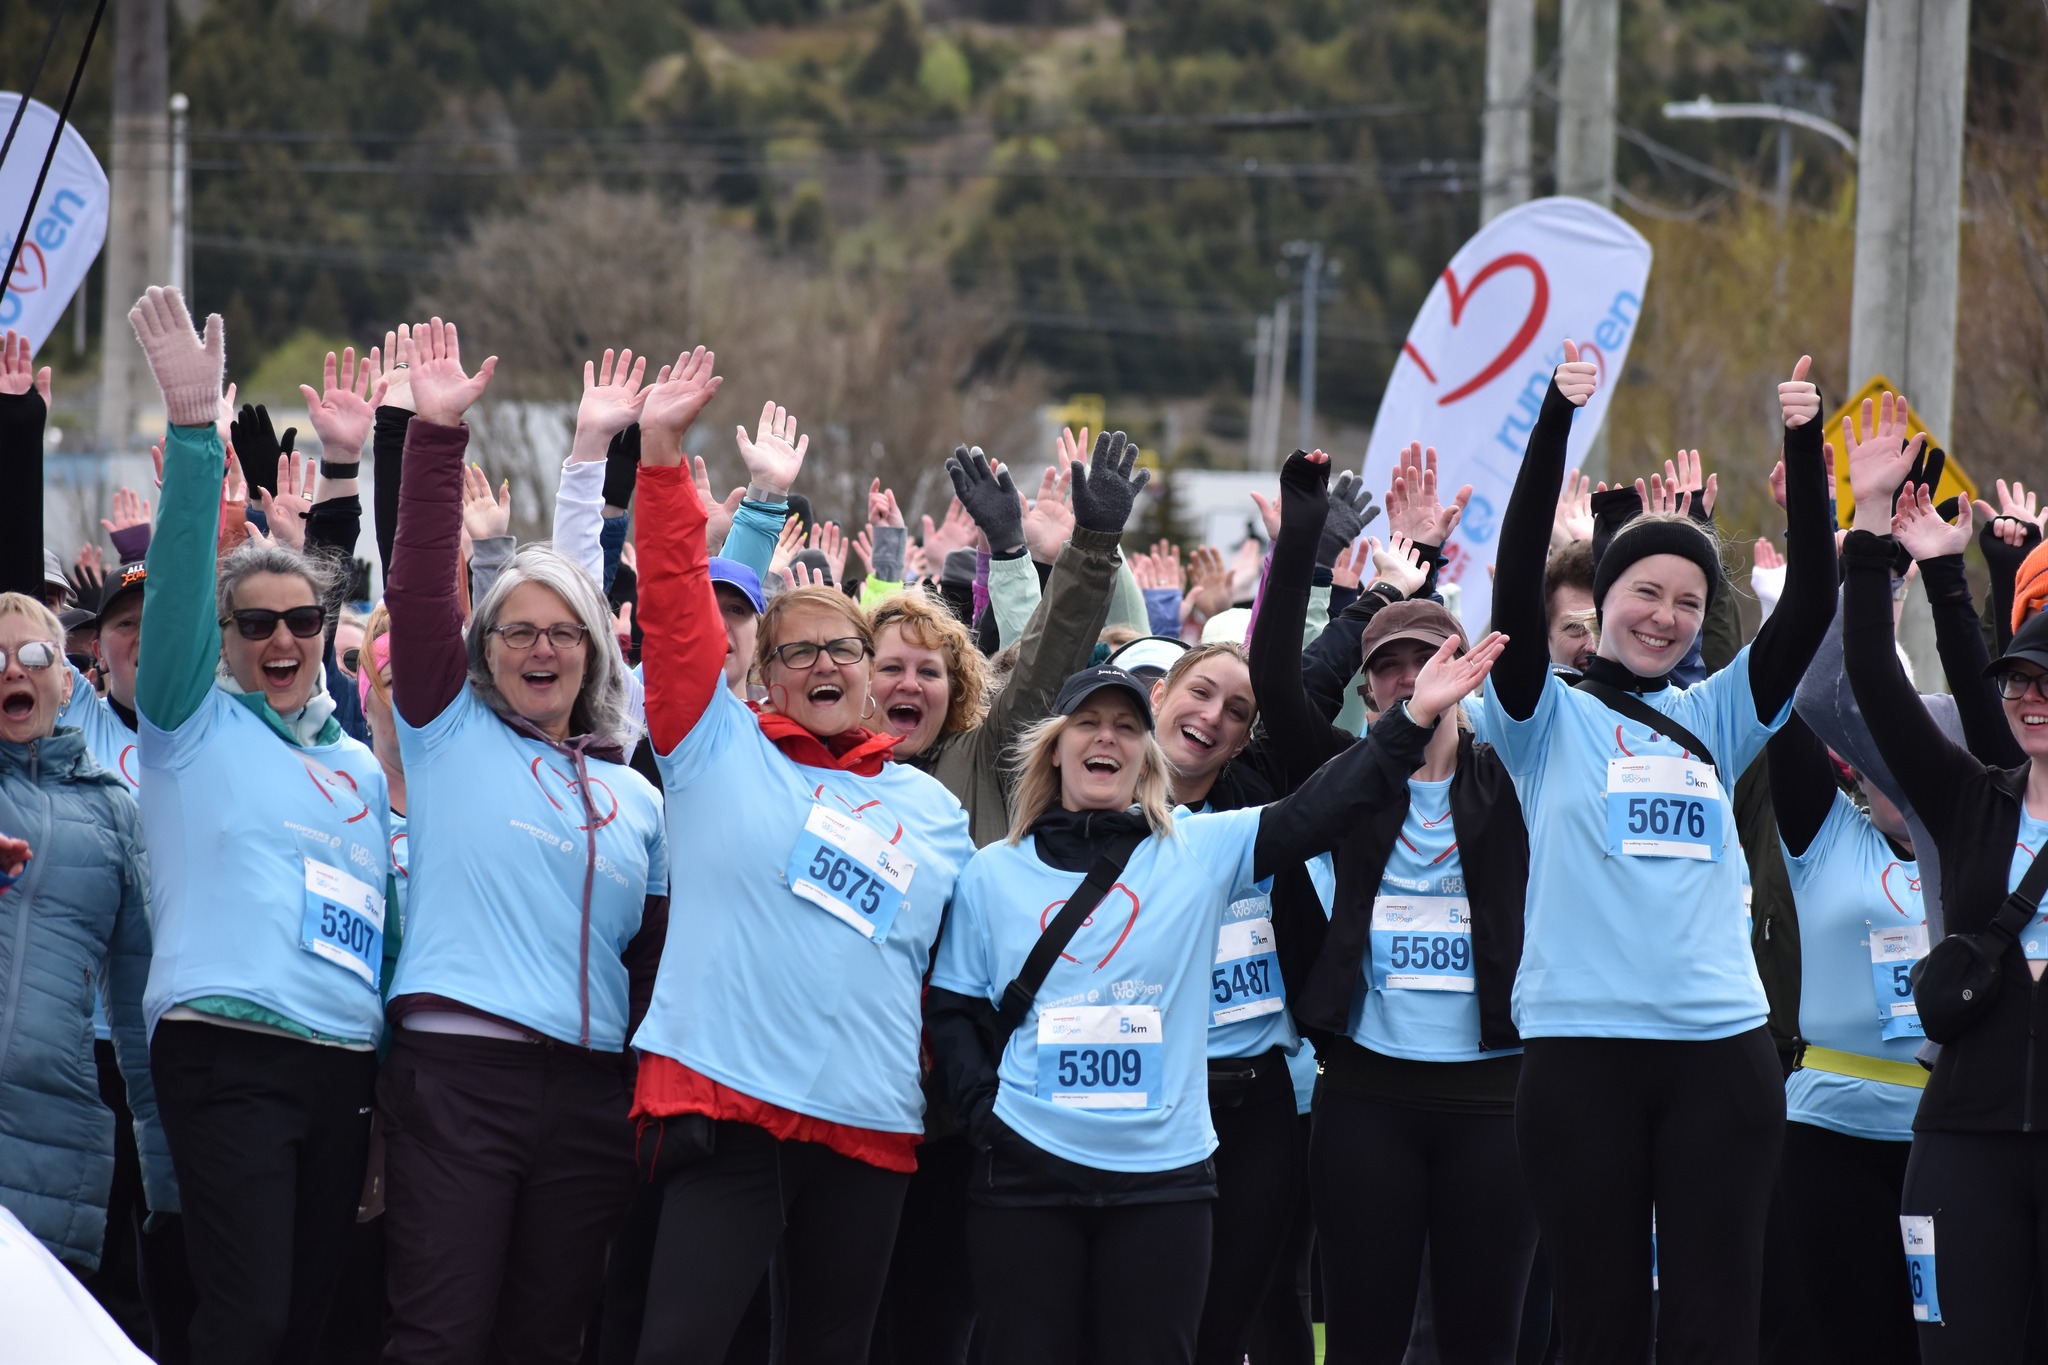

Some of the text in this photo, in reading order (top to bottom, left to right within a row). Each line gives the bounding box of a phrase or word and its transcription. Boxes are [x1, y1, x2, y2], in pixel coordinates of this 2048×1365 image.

[1685, 770, 1709, 788] 5km
[1628, 798, 1705, 838] 5676
[509, 819, 561, 844] SHOPPERS
[877, 850, 899, 879] 5km
[809, 844, 886, 915] 5675
[1383, 873, 1417, 887] OPPERS
[1442, 877, 1462, 887] run
[364, 893, 380, 918] 5km
[321, 902, 375, 960] 5307
[1250, 930, 1269, 946] 5km
[1391, 936, 1470, 971] 5589
[1111, 980, 1134, 993] run
[1112, 983, 1163, 1001] women
[1211, 958, 1271, 1004] 5487
[1119, 1016, 1147, 1034] 5km
[1058, 1048, 1142, 1087] 5309
[1908, 1228, 1924, 1245] 5km
